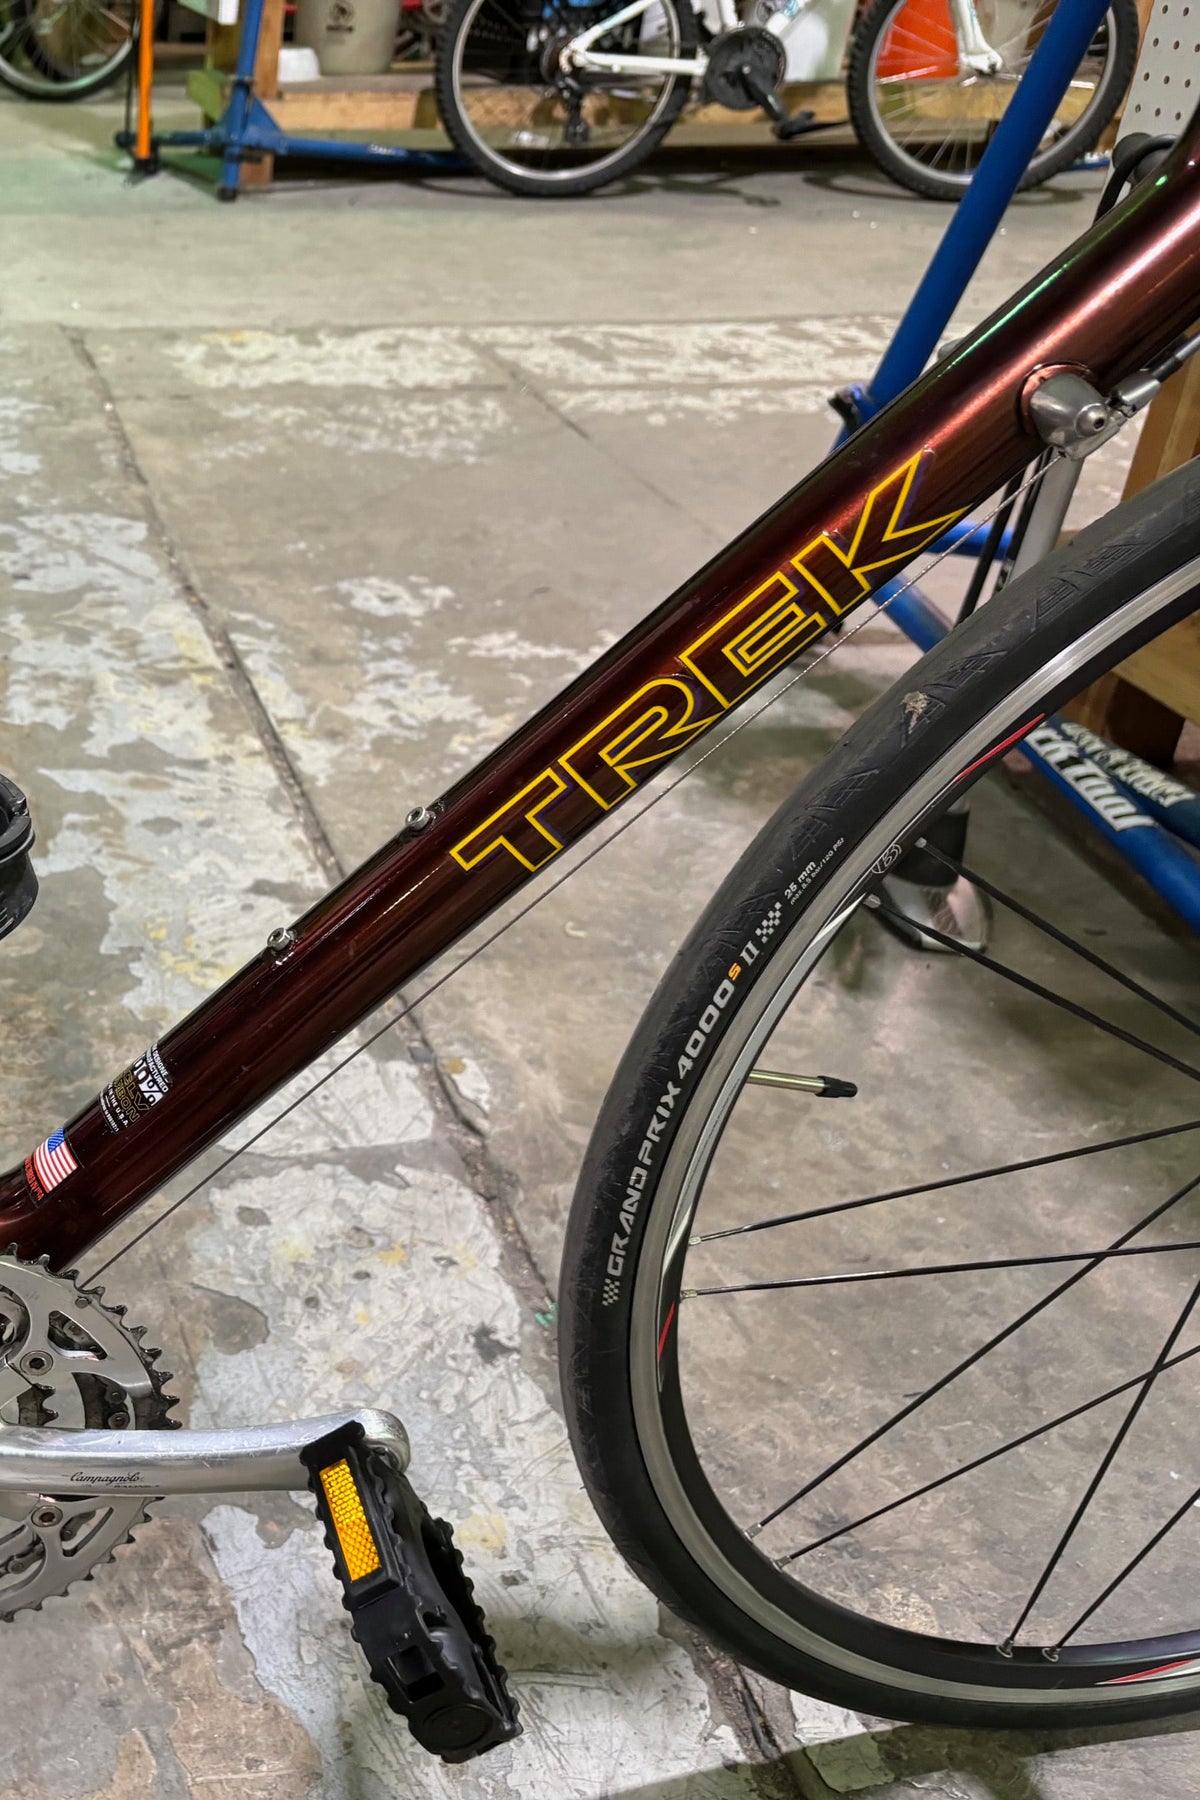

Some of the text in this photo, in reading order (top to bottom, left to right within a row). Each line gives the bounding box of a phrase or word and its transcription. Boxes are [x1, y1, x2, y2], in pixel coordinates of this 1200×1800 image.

[449, 448, 975, 873] TREK
[784, 861, 817, 899] 25 mm
[606, 1166, 648, 1277] GRAND
[638, 1080, 681, 1167] PRIX
[70, 1471, 142, 1486] Campagnolo
